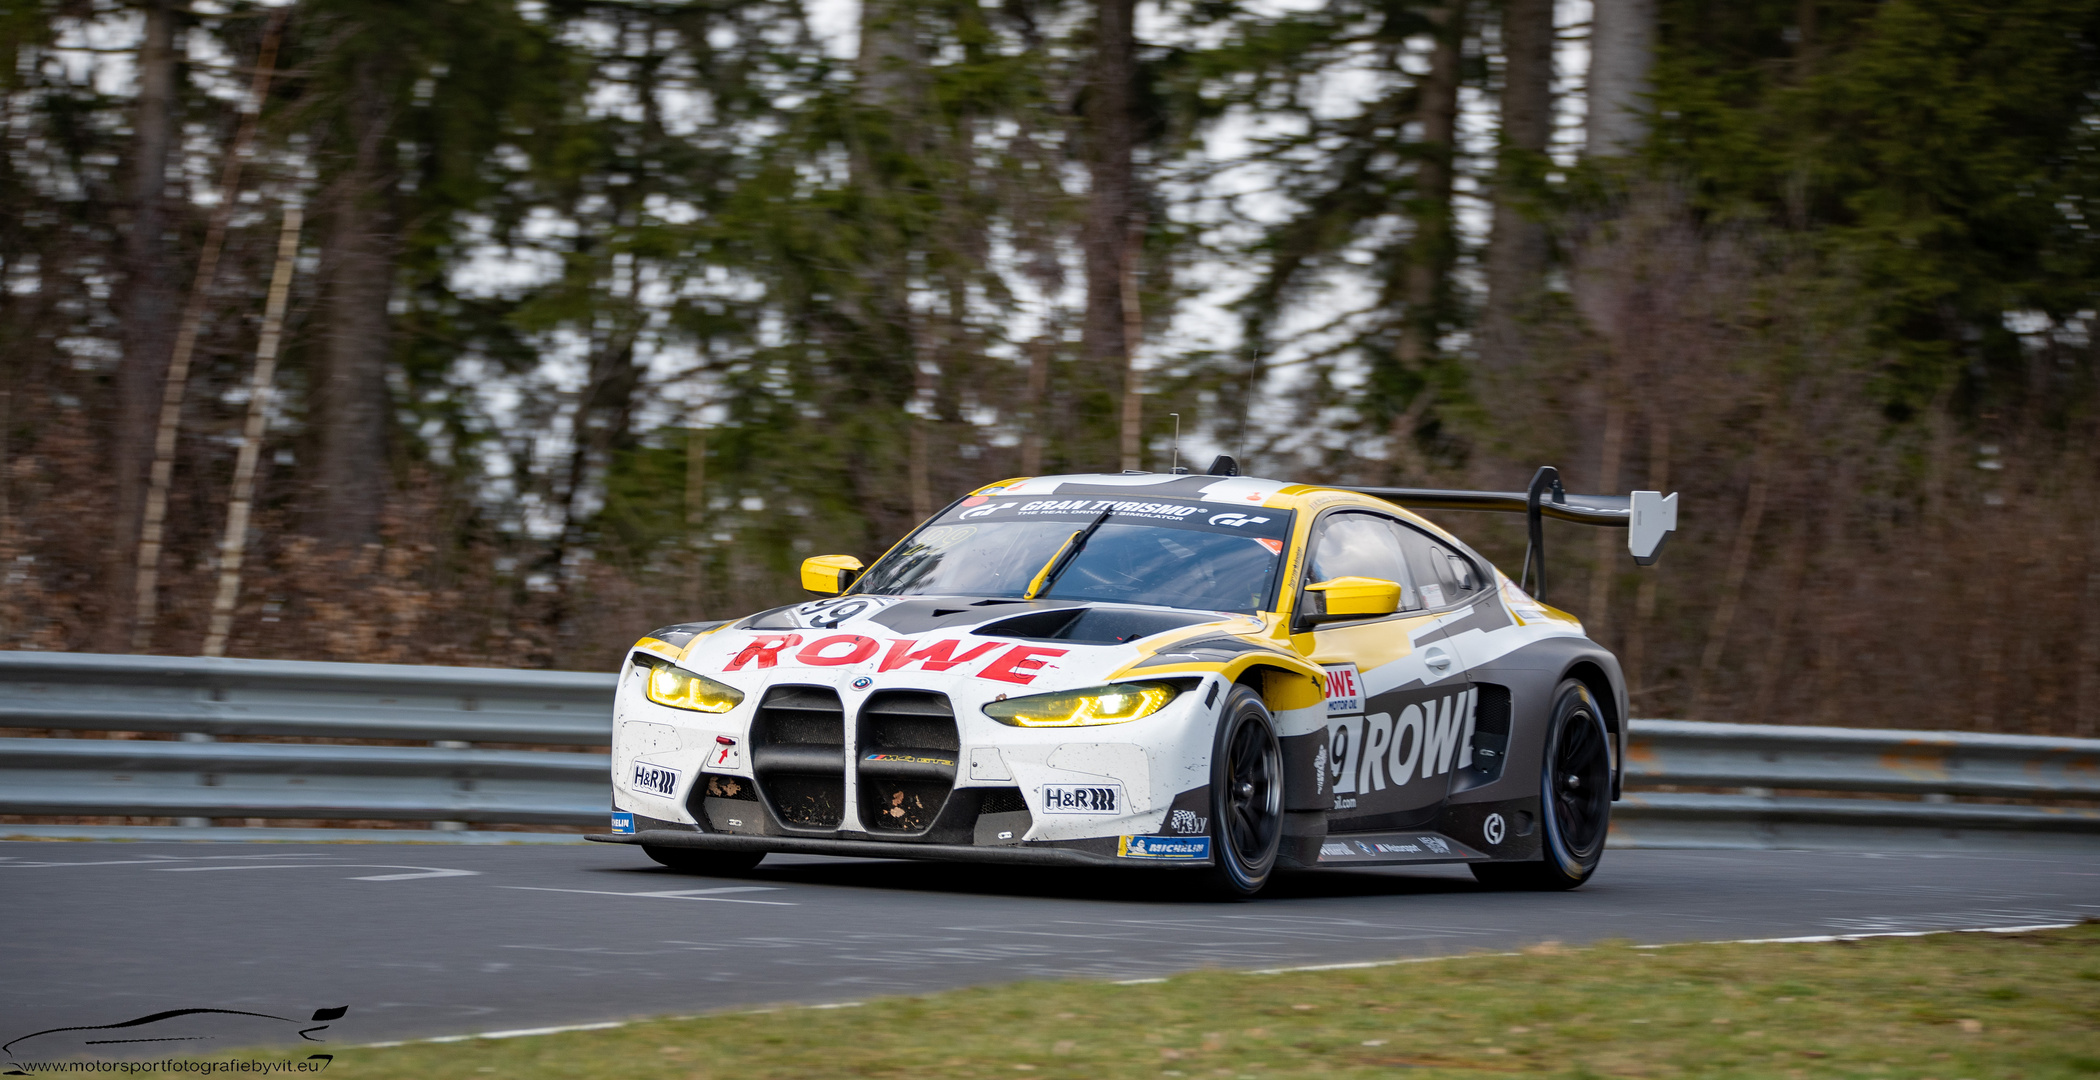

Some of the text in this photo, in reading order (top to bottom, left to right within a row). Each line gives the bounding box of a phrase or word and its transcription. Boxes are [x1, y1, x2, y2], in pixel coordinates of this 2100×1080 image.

[1020, 500, 1092, 511] GRAN
[1118, 511, 1184, 521] SIMULATOR
[800, 596, 869, 628] 99
[722, 634, 1071, 685] ROWE
[1325, 670, 1356, 699] OWE
[1328, 699, 1357, 711] MOTOR OIL
[1359, 686, 1479, 795] ROWE
[634, 765, 660, 790] H&R
[1046, 788, 1090, 809] H&R
[1149, 844, 1205, 853] MICHELIN
